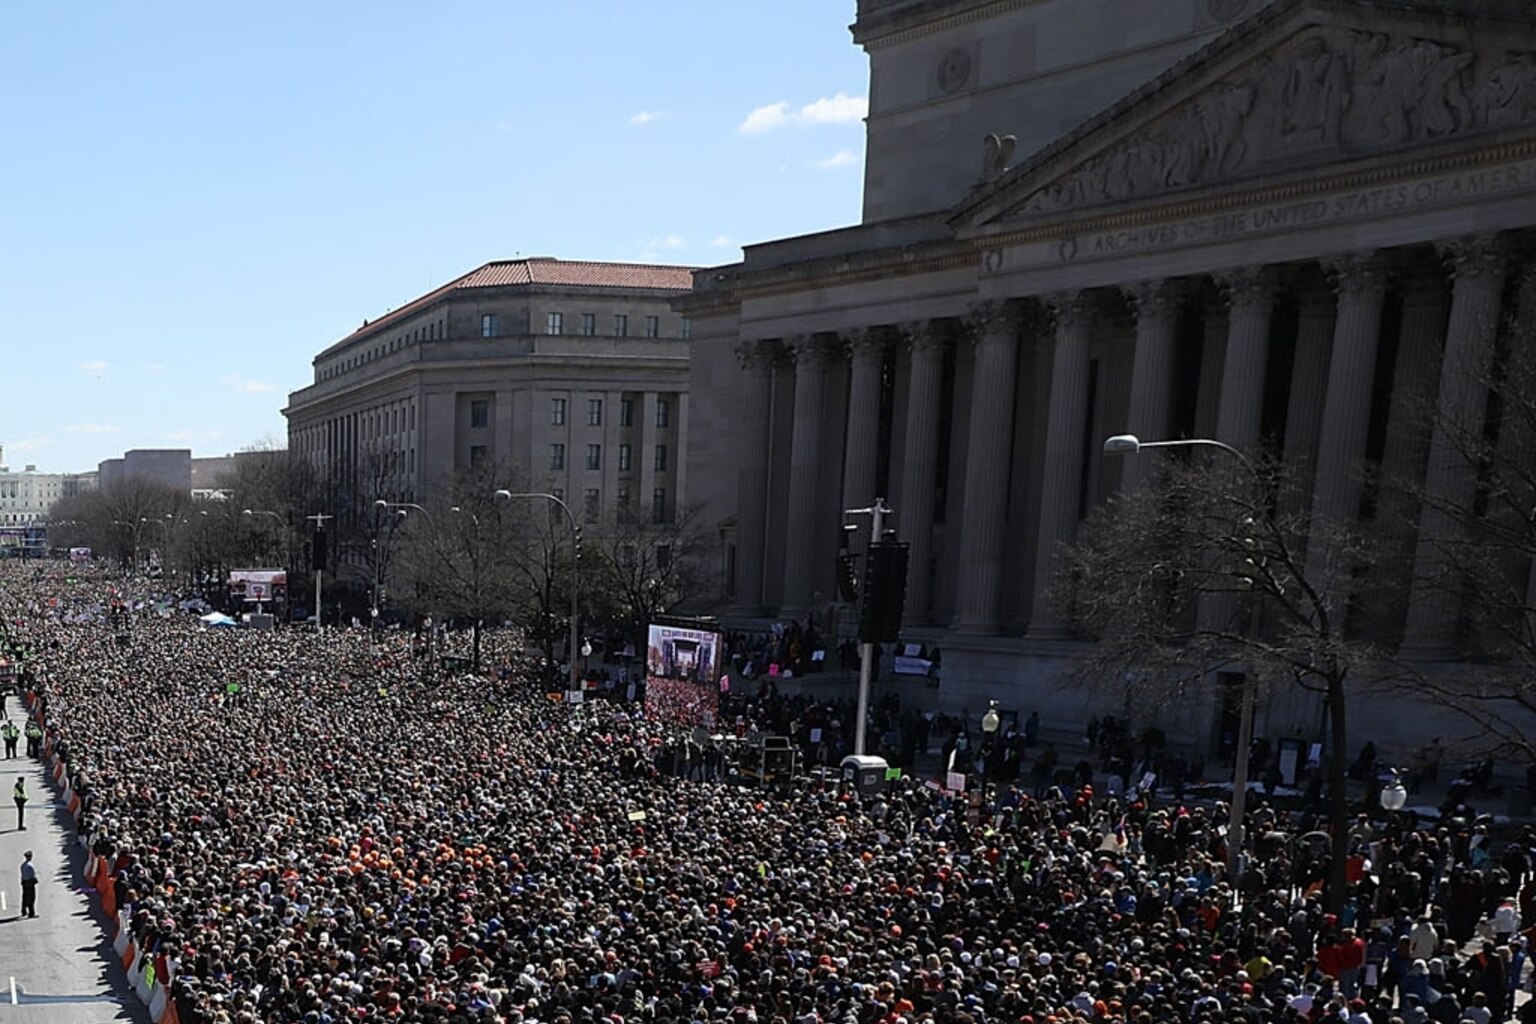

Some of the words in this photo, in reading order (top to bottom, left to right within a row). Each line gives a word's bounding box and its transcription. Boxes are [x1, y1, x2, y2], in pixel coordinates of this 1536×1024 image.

[1093, 226, 1177, 252] ARCHIVES
[1184, 220, 1207, 239] OF
[1213, 213, 1247, 237] THE
[1252, 201, 1328, 230] UNITED
[1333, 186, 1407, 214] STATES
[1414, 178, 1444, 203] OF
[1449, 164, 1536, 196] AMERI
